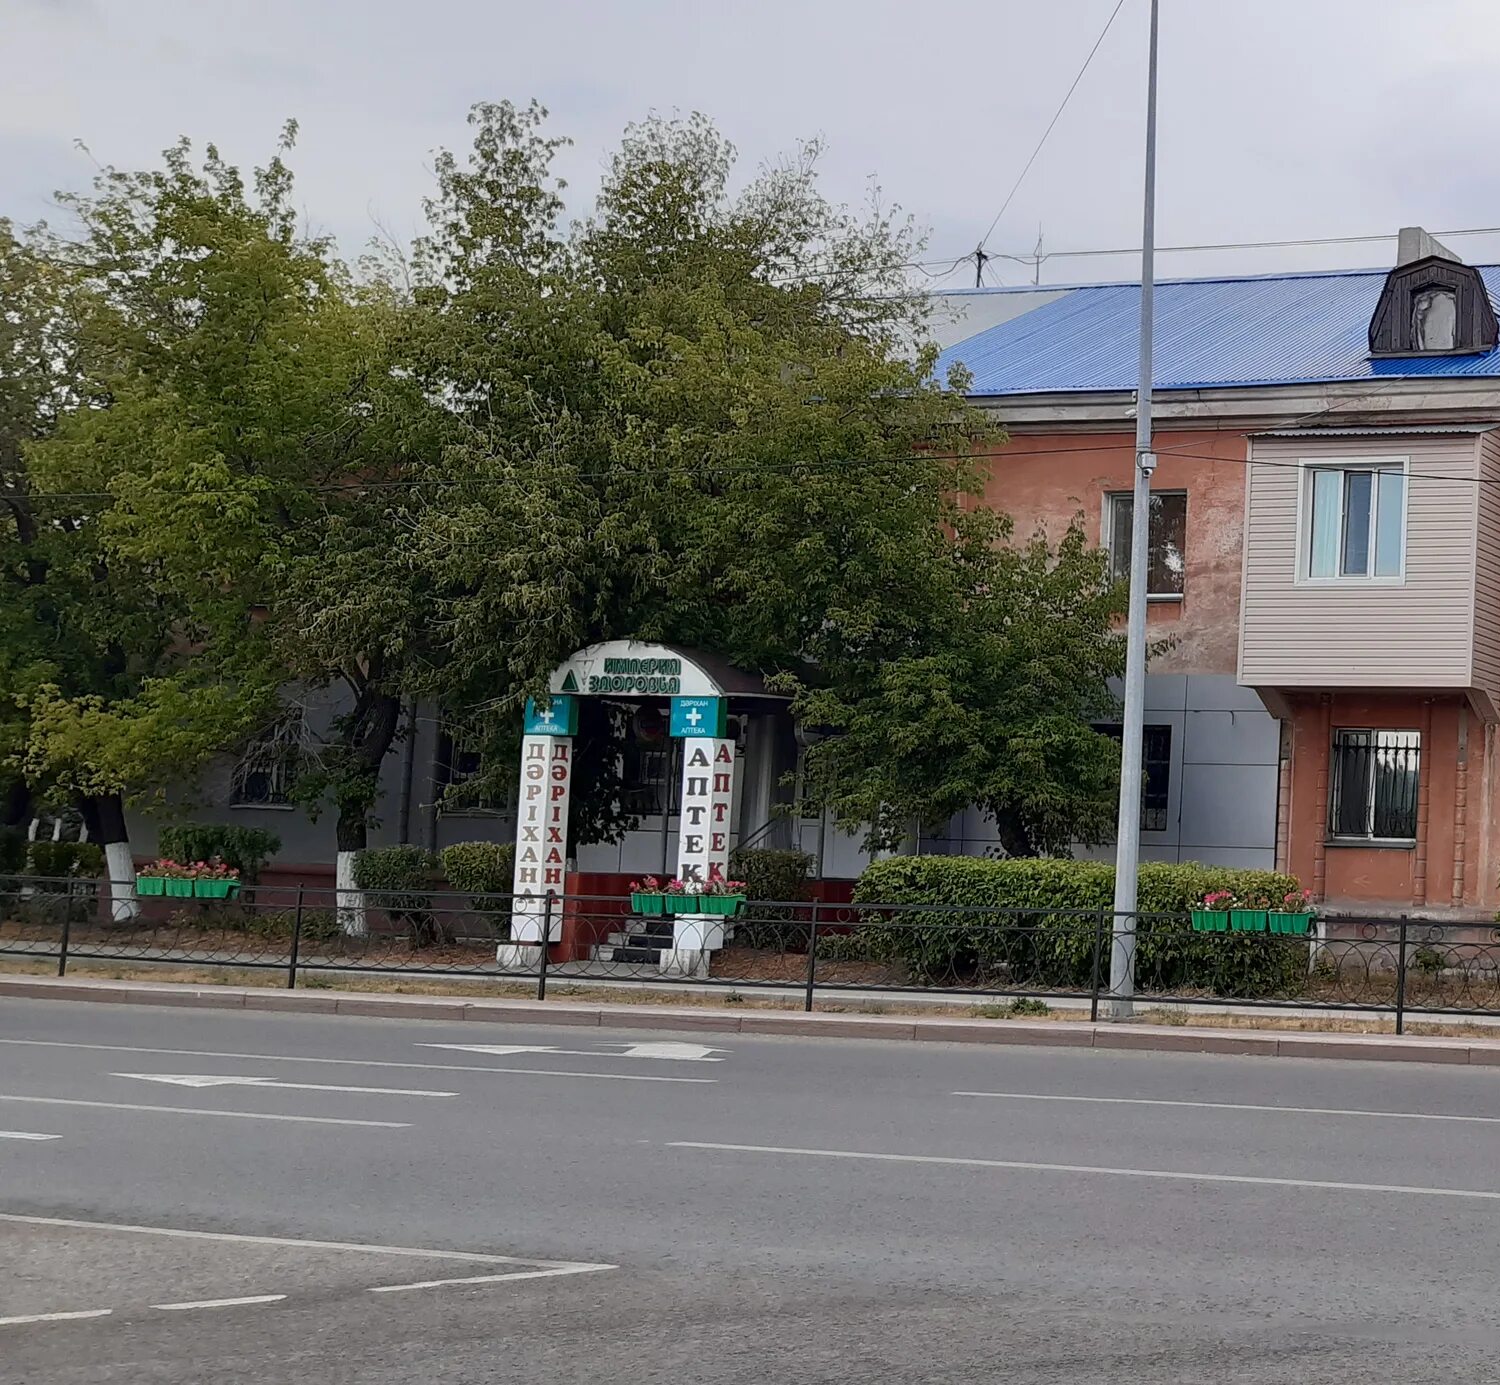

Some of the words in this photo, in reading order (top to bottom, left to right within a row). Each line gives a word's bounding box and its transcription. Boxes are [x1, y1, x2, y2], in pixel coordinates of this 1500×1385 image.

[588, 675, 681, 694] ЗДОРОВЬЯ
[604, 657, 681, 675] ИМПЕРИЯ
[681, 747, 711, 883] АПТЕК
[707, 743, 732, 883] АПТЕК
